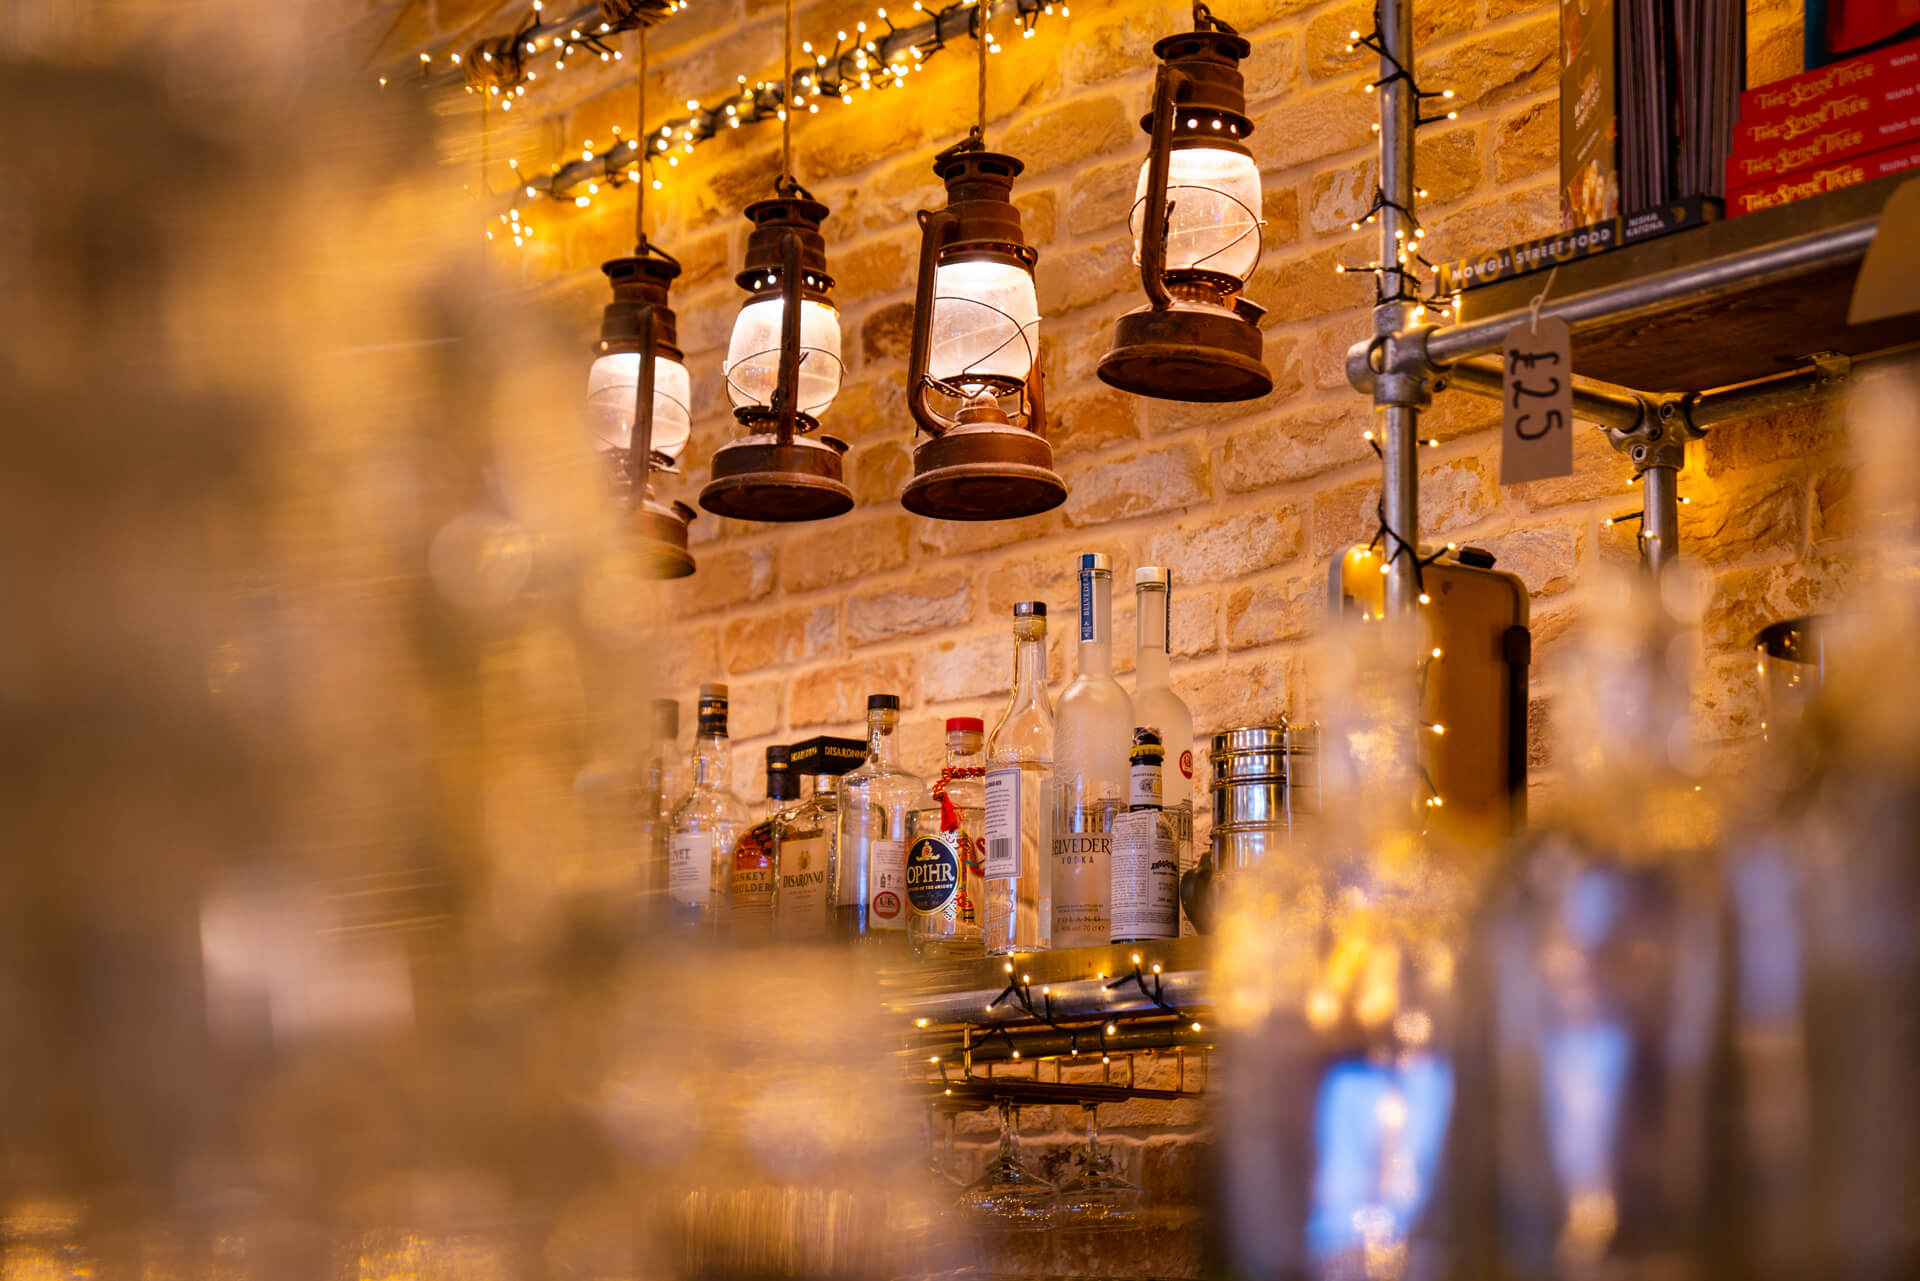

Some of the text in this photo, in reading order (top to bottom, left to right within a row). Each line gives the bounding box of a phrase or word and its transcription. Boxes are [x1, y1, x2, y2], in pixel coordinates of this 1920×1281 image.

[1452, 229, 1611, 281] MOWGLI STREET FOOD
[1509, 349, 1563, 440] £25
[825, 746, 867, 759] DISARONNO
[1052, 838, 1112, 856] ELVEDER
[1062, 856, 1094, 865] VODKA
[783, 871, 825, 889] DISARONNO
[907, 863, 955, 884] OPIHR
